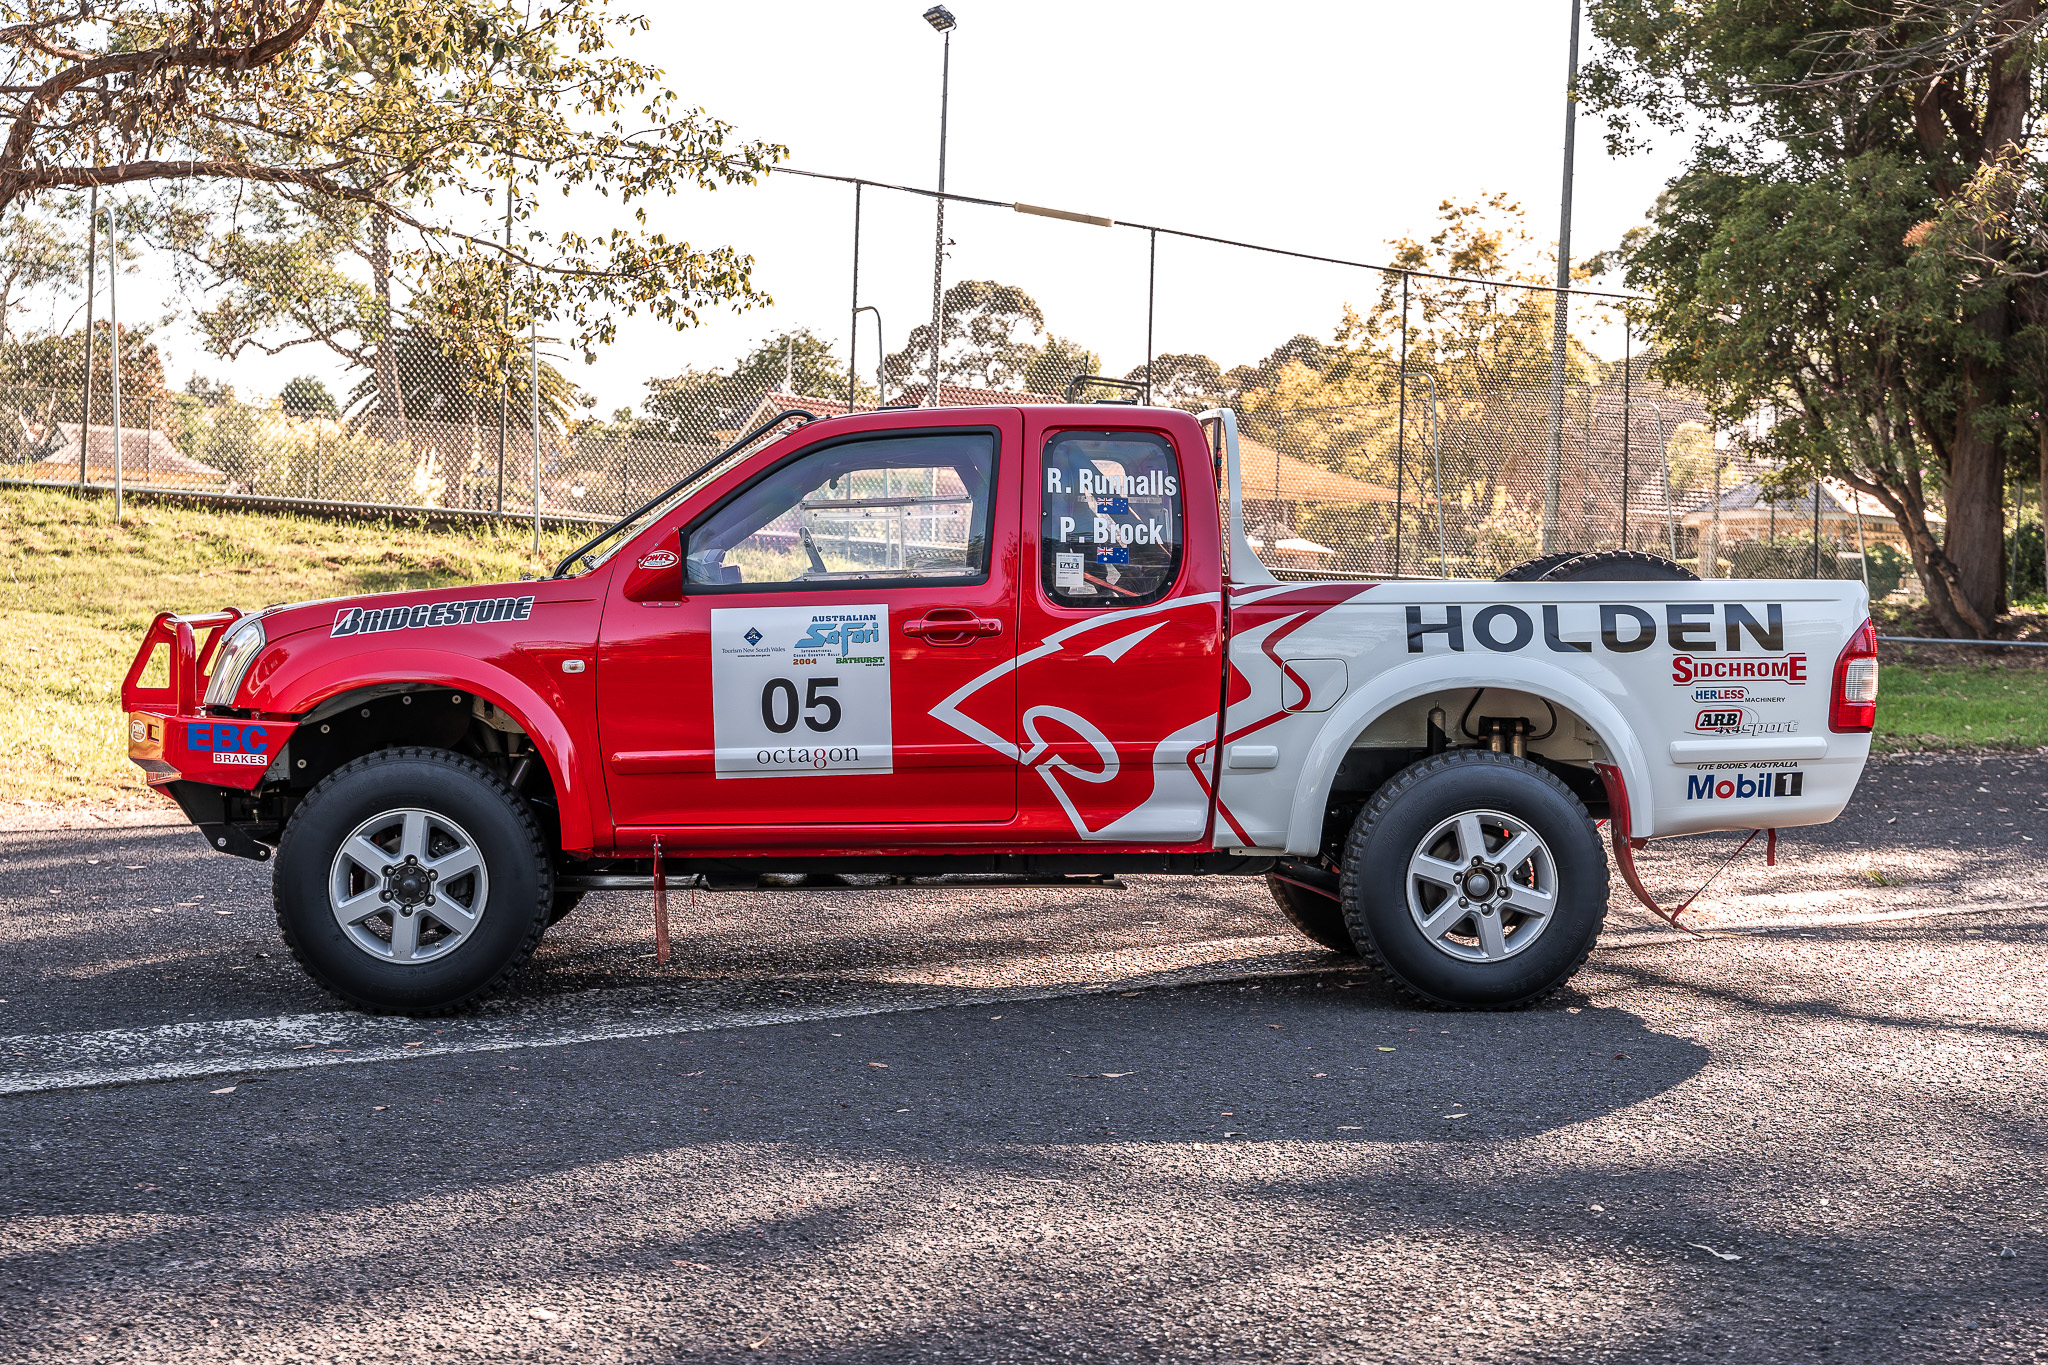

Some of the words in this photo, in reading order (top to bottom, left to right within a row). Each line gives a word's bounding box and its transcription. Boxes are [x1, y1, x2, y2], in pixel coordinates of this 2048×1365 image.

[1047, 467, 1072, 494] R.
[1079, 468, 1177, 497] Runnalls
[1060, 516, 1086, 544] P.
[1094, 516, 1164, 545] Brock
[330, 596, 535, 638] BRIDGESTONE
[811, 614, 877, 623] AUSTRALIAN
[1405, 604, 1784, 653] HOLDEN
[794, 622, 879, 657] Safari
[793, 658, 817, 666] 2004
[836, 656, 885, 665] BATHURST
[1672, 656, 1807, 683] SIDCHROME
[761, 677, 842, 734] 05
[1695, 690, 1745, 700] HERLESS
[1700, 713, 1738, 727] ARB
[187, 723, 268, 754] EBC
[214, 754, 267, 765] BRAKES
[1716, 762, 1749, 770] BODIES
[1750, 761, 1798, 769] AUSTRALIA
[1687, 772, 1773, 800] Mobil
